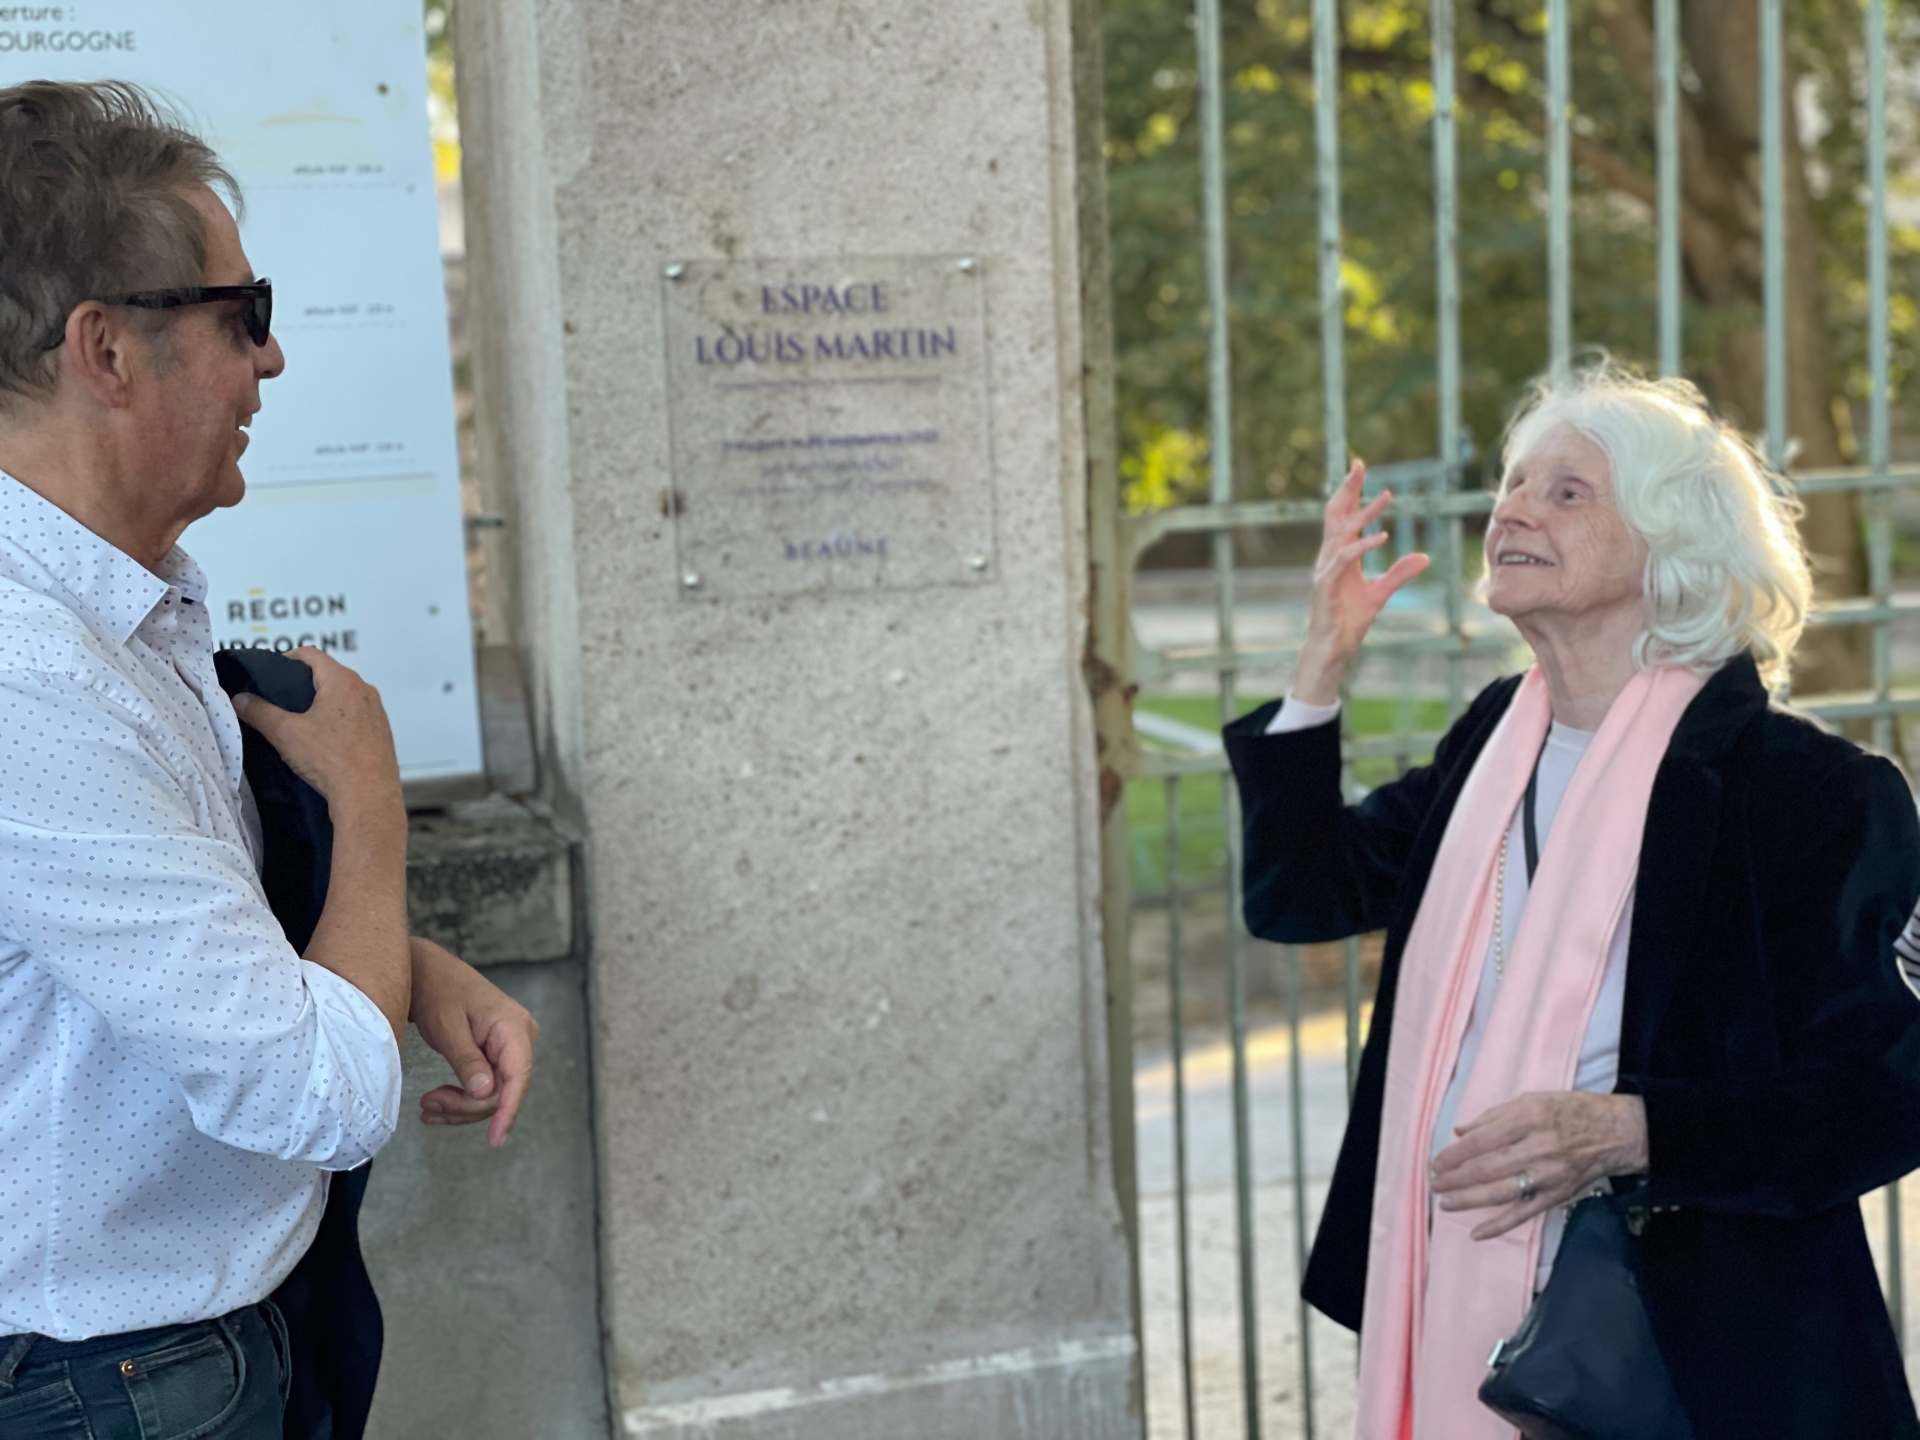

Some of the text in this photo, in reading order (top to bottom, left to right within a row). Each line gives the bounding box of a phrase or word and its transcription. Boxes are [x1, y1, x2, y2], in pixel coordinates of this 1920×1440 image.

[0, 30, 137, 52] OURGOGNE
[761, 283, 889, 314] ESPACE
[696, 326, 956, 365] LOUIS MARTIN
